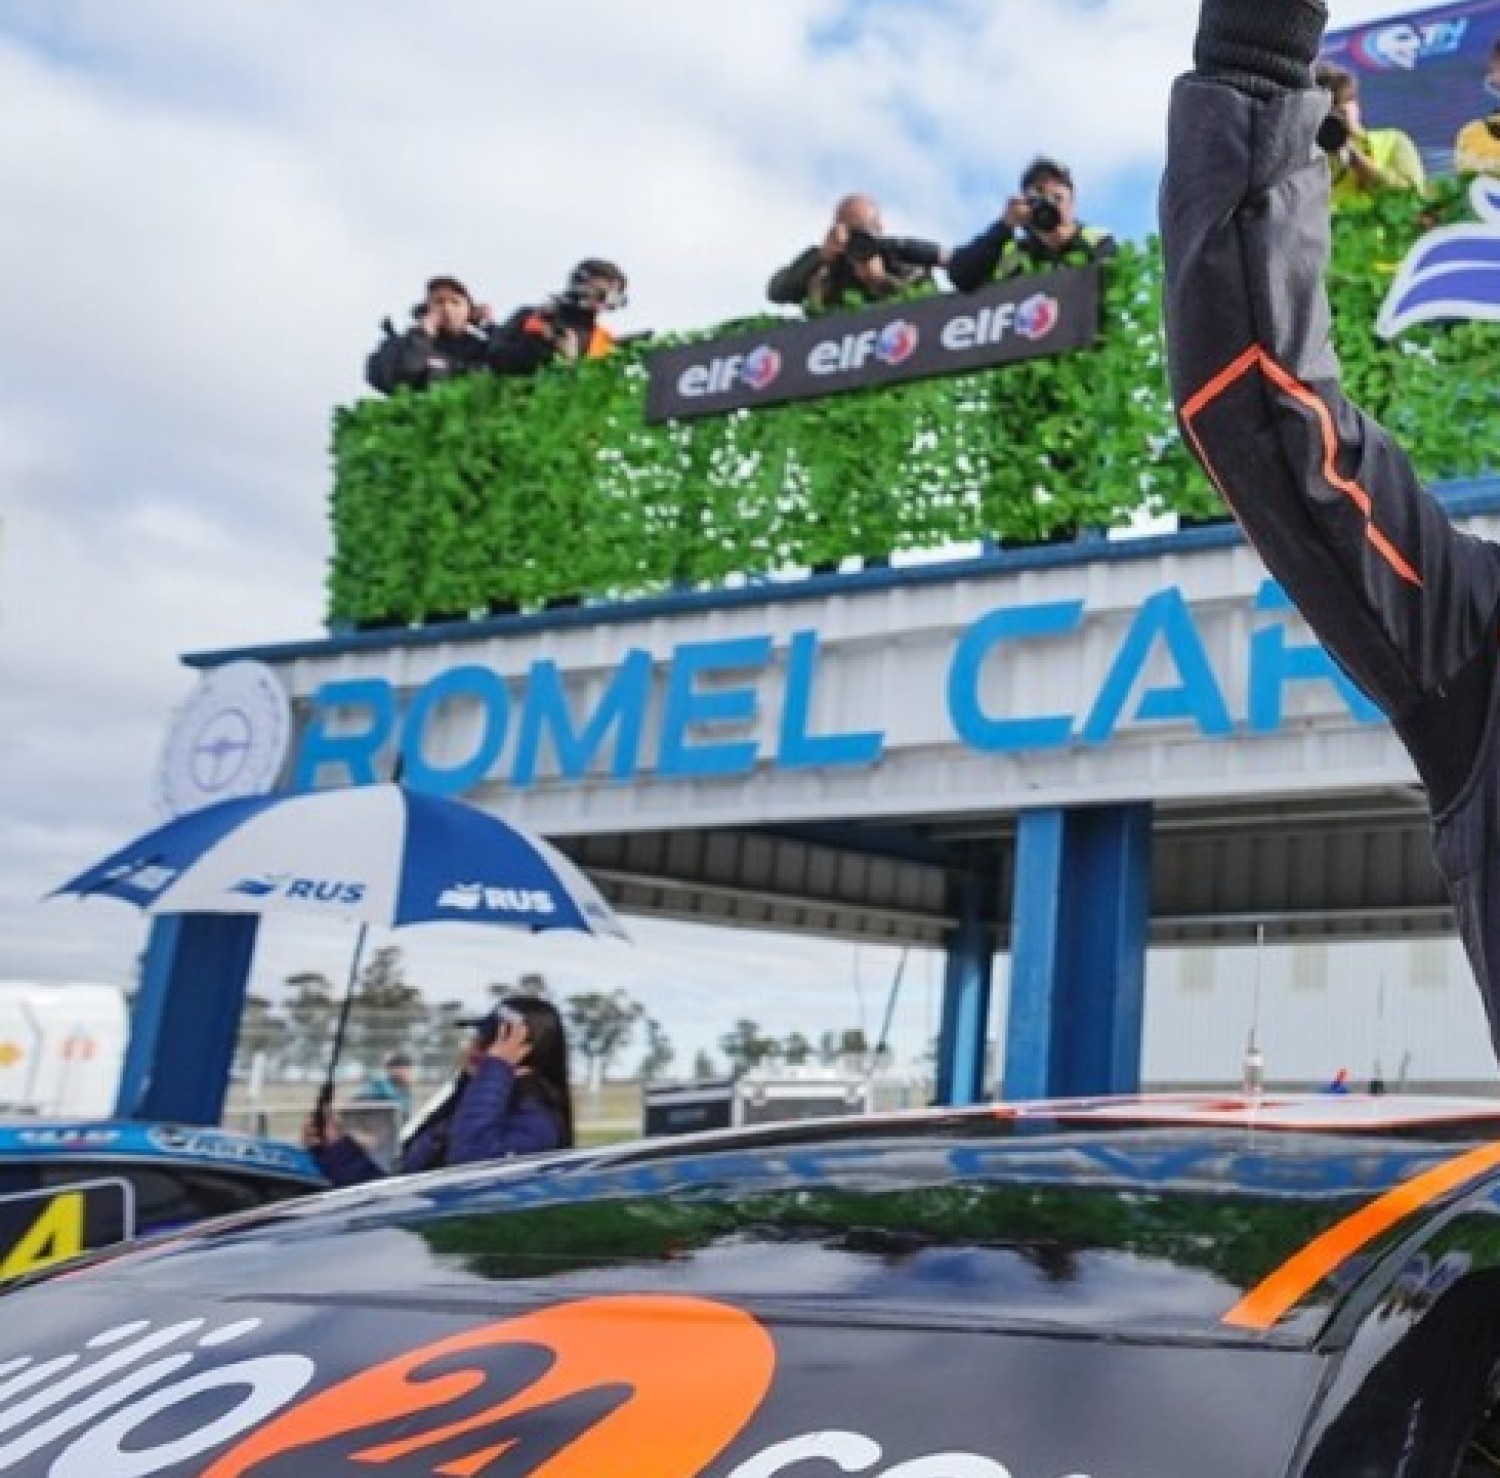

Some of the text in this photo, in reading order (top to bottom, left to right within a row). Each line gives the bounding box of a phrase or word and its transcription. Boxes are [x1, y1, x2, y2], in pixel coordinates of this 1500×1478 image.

[940, 301, 1016, 351] elf
[805, 329, 877, 375] elf
[676, 354, 744, 397] elf
[293, 629, 886, 797] ROMEL
[286, 877, 367, 905] RUS
[484, 886, 558, 914] RUS
